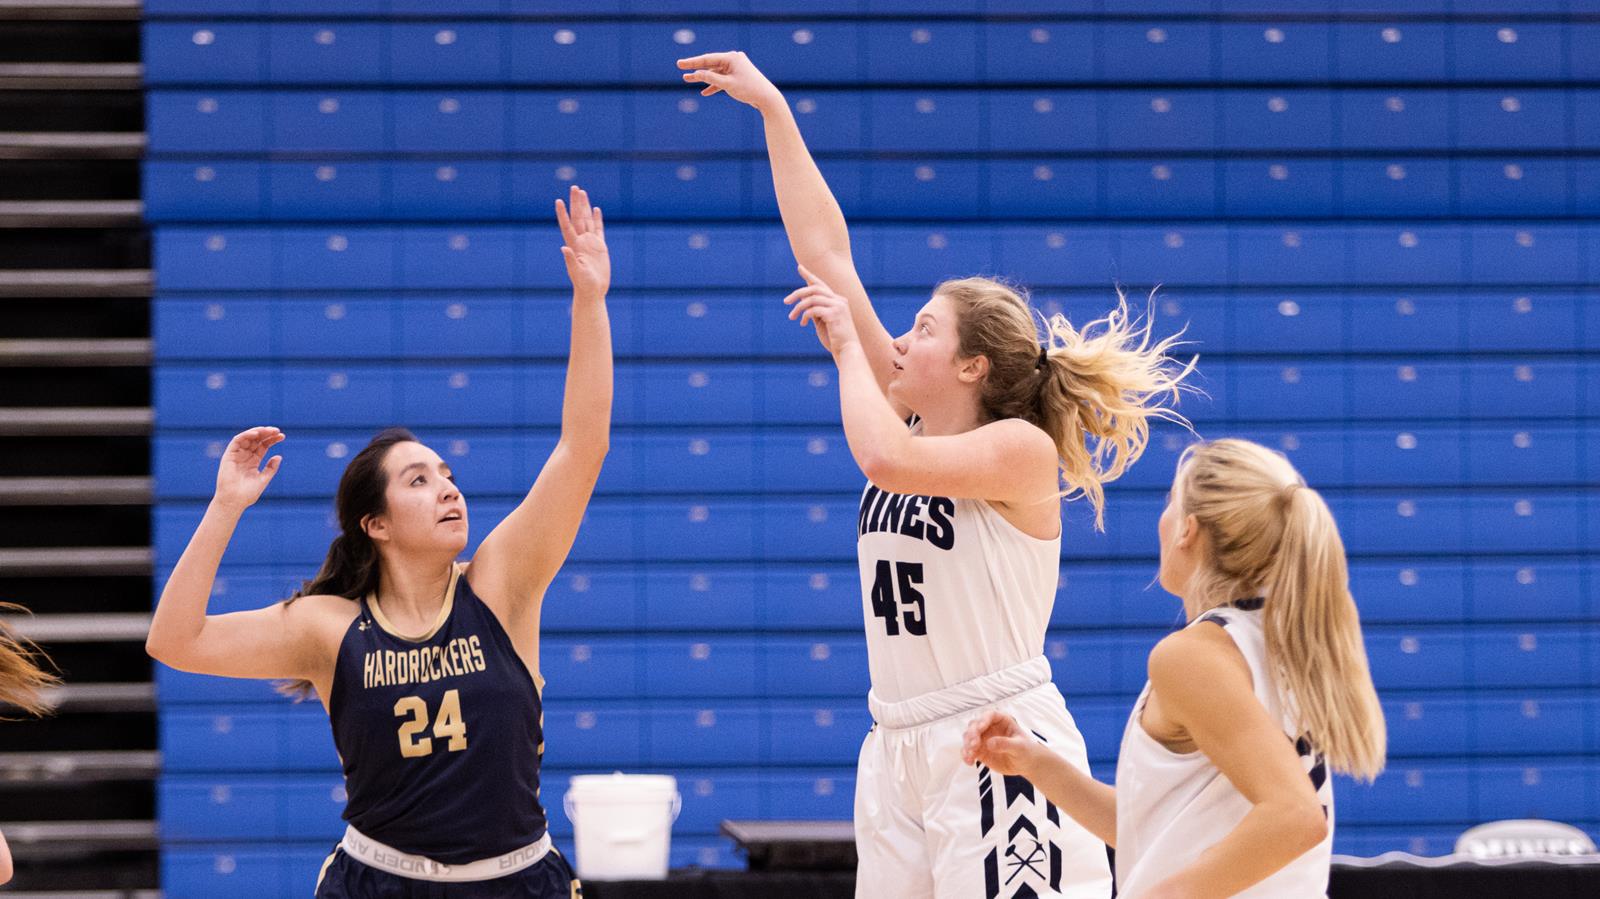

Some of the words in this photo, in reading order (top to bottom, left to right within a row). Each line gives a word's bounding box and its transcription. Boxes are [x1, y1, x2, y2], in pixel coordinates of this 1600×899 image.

[871, 559, 927, 636] 45
[363, 634, 487, 689] HARDROCKERS
[393, 689, 467, 759] 24
